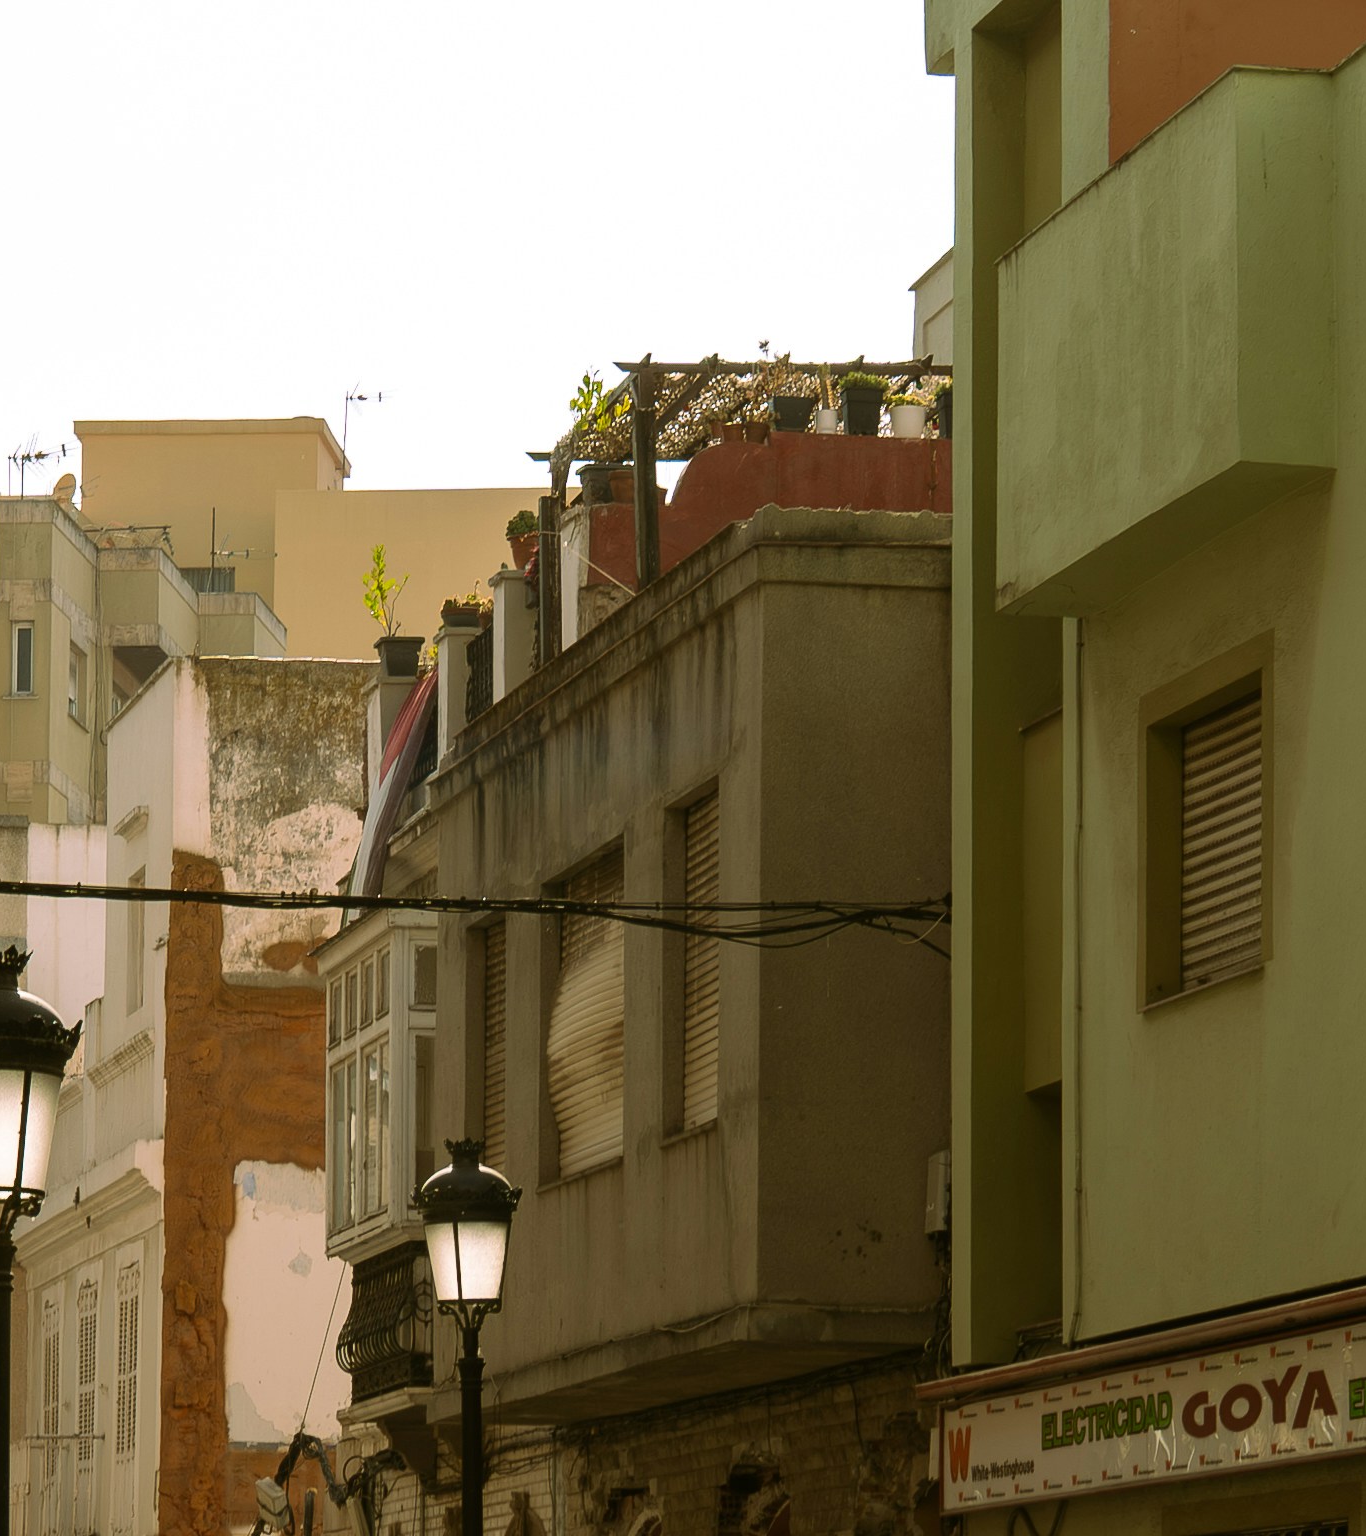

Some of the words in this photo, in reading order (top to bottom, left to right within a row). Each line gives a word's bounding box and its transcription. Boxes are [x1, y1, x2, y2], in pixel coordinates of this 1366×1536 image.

[1041, 1391, 1173, 1451] ELECTRICIDAD
[1182, 1363, 1338, 1438] GOYA
[948, 1425, 971, 1484] W
[971, 1458, 1035, 1483] White-Westinghouse
